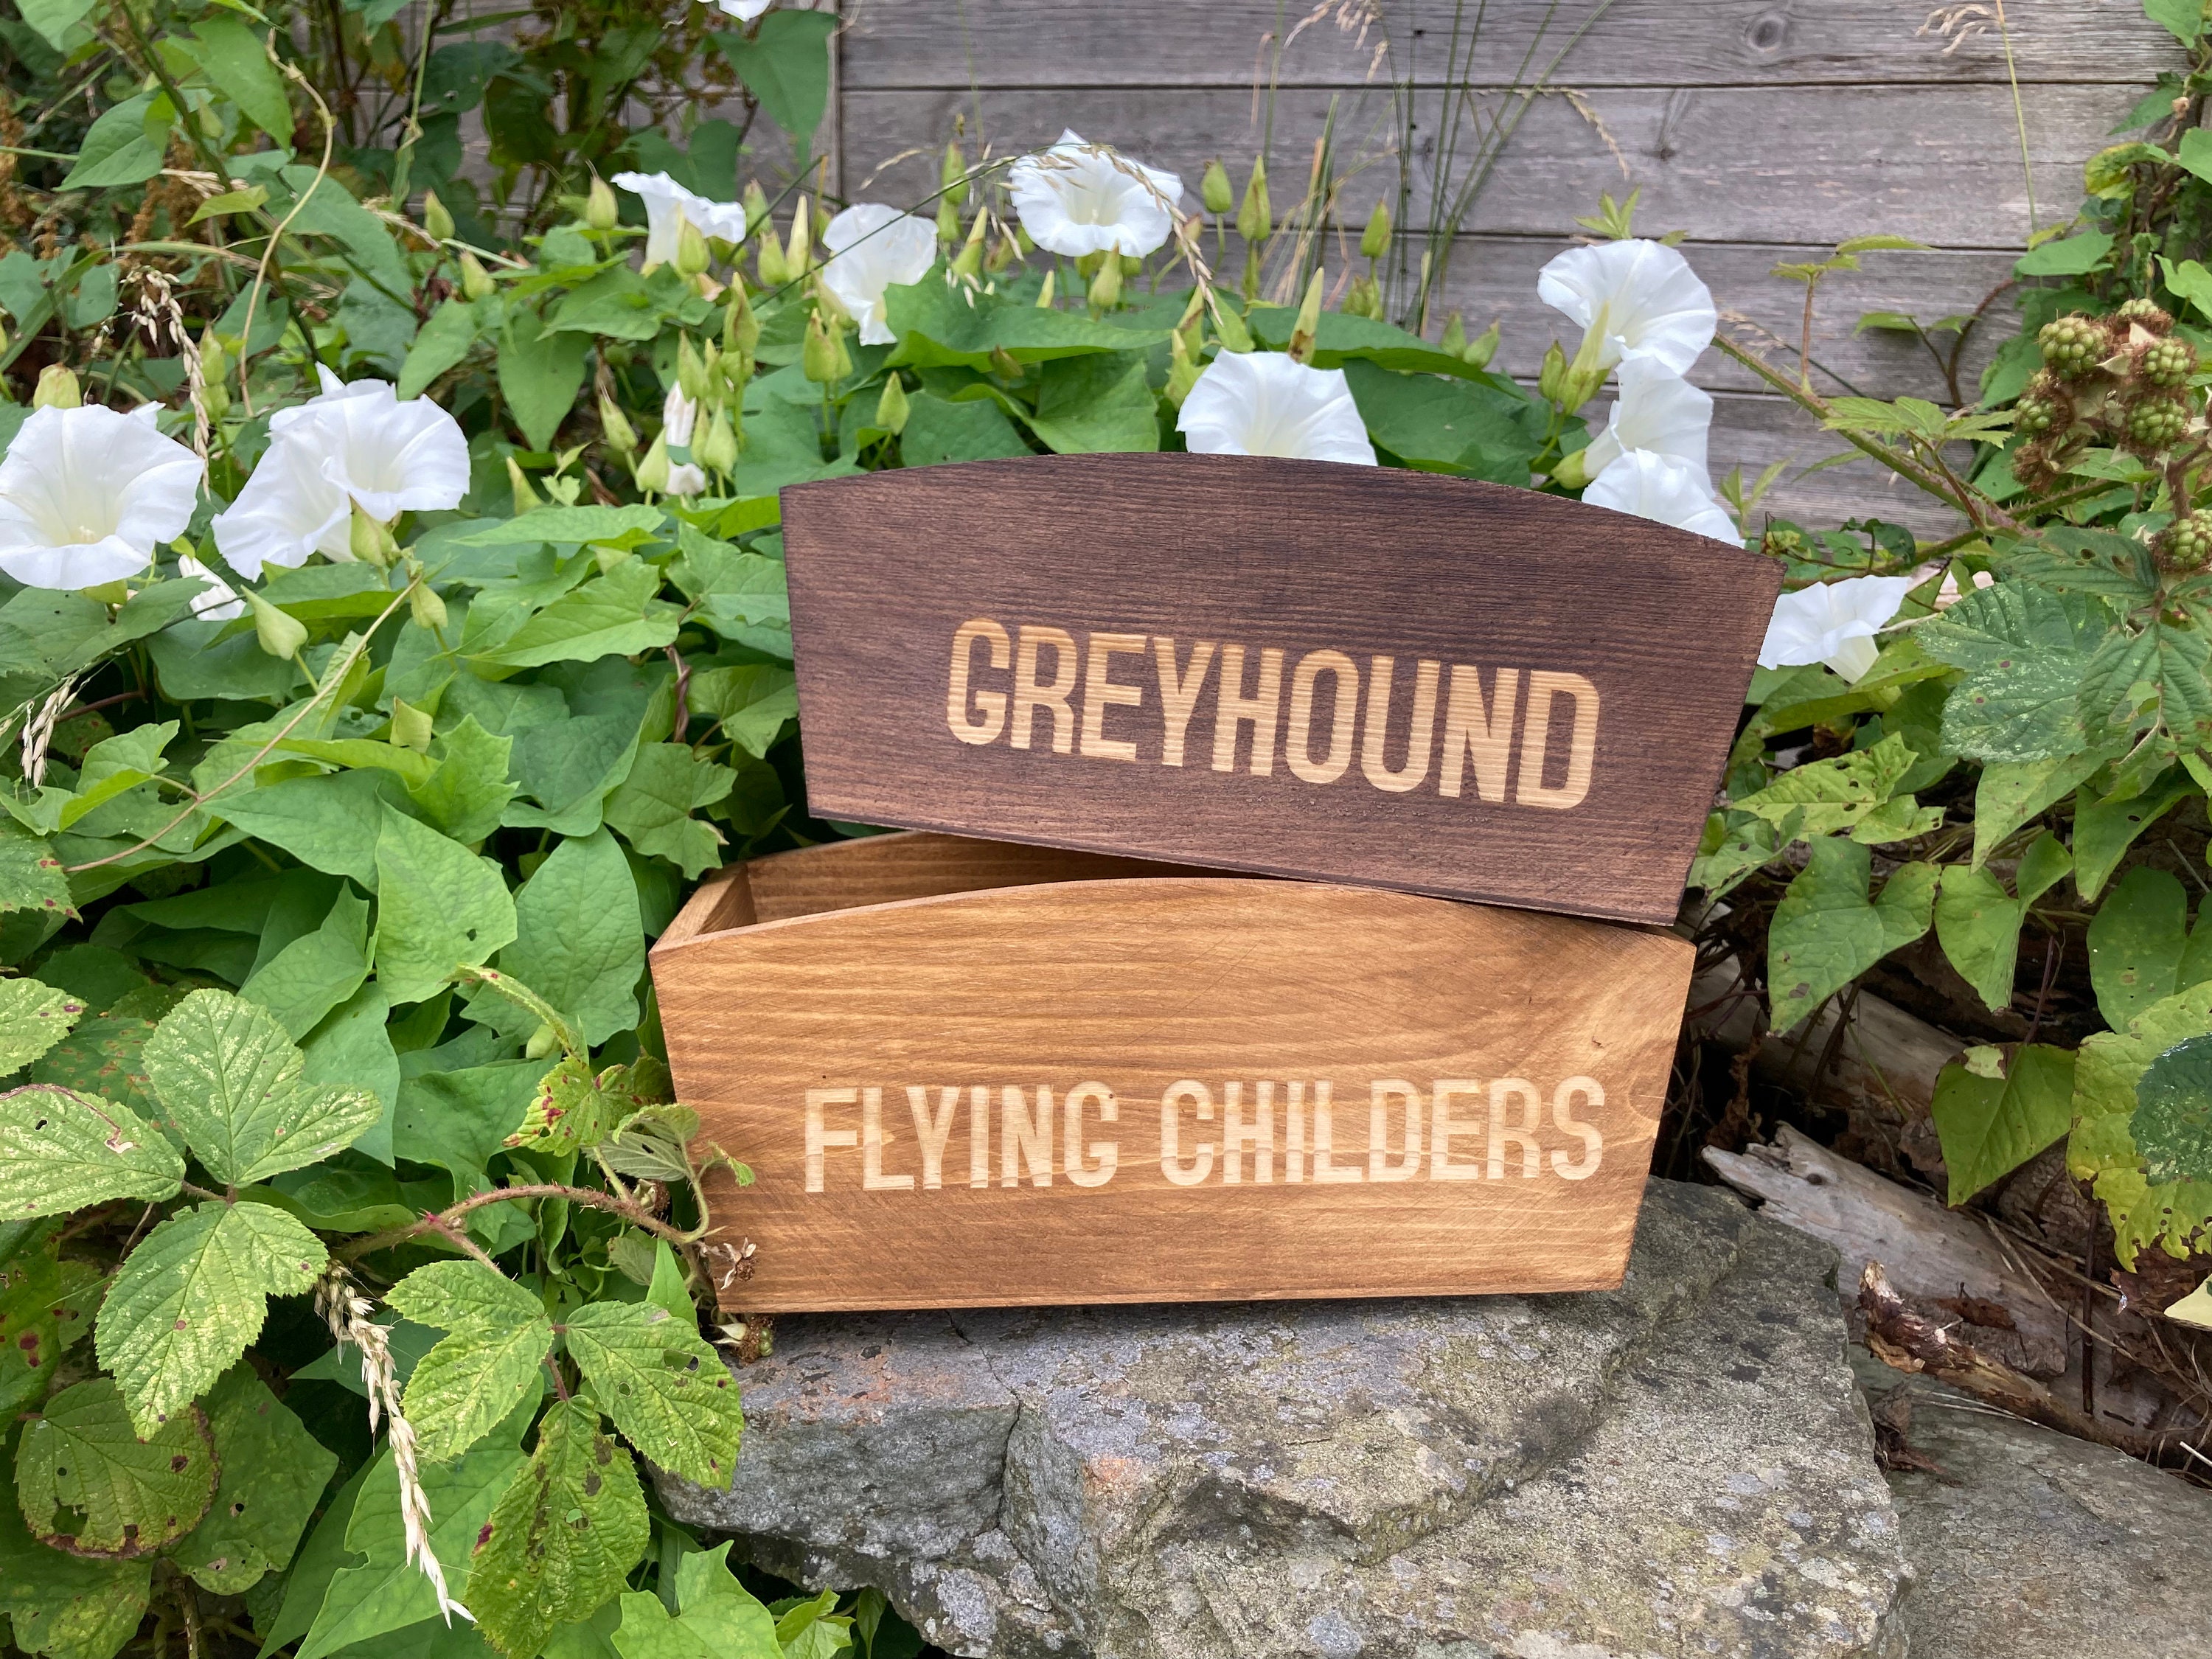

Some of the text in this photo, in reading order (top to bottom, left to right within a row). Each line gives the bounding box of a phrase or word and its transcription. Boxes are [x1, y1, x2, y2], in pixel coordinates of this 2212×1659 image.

[946, 618, 1600, 808] GREYHOUND
[804, 1077, 1604, 1192] FLYING CHILDERS
